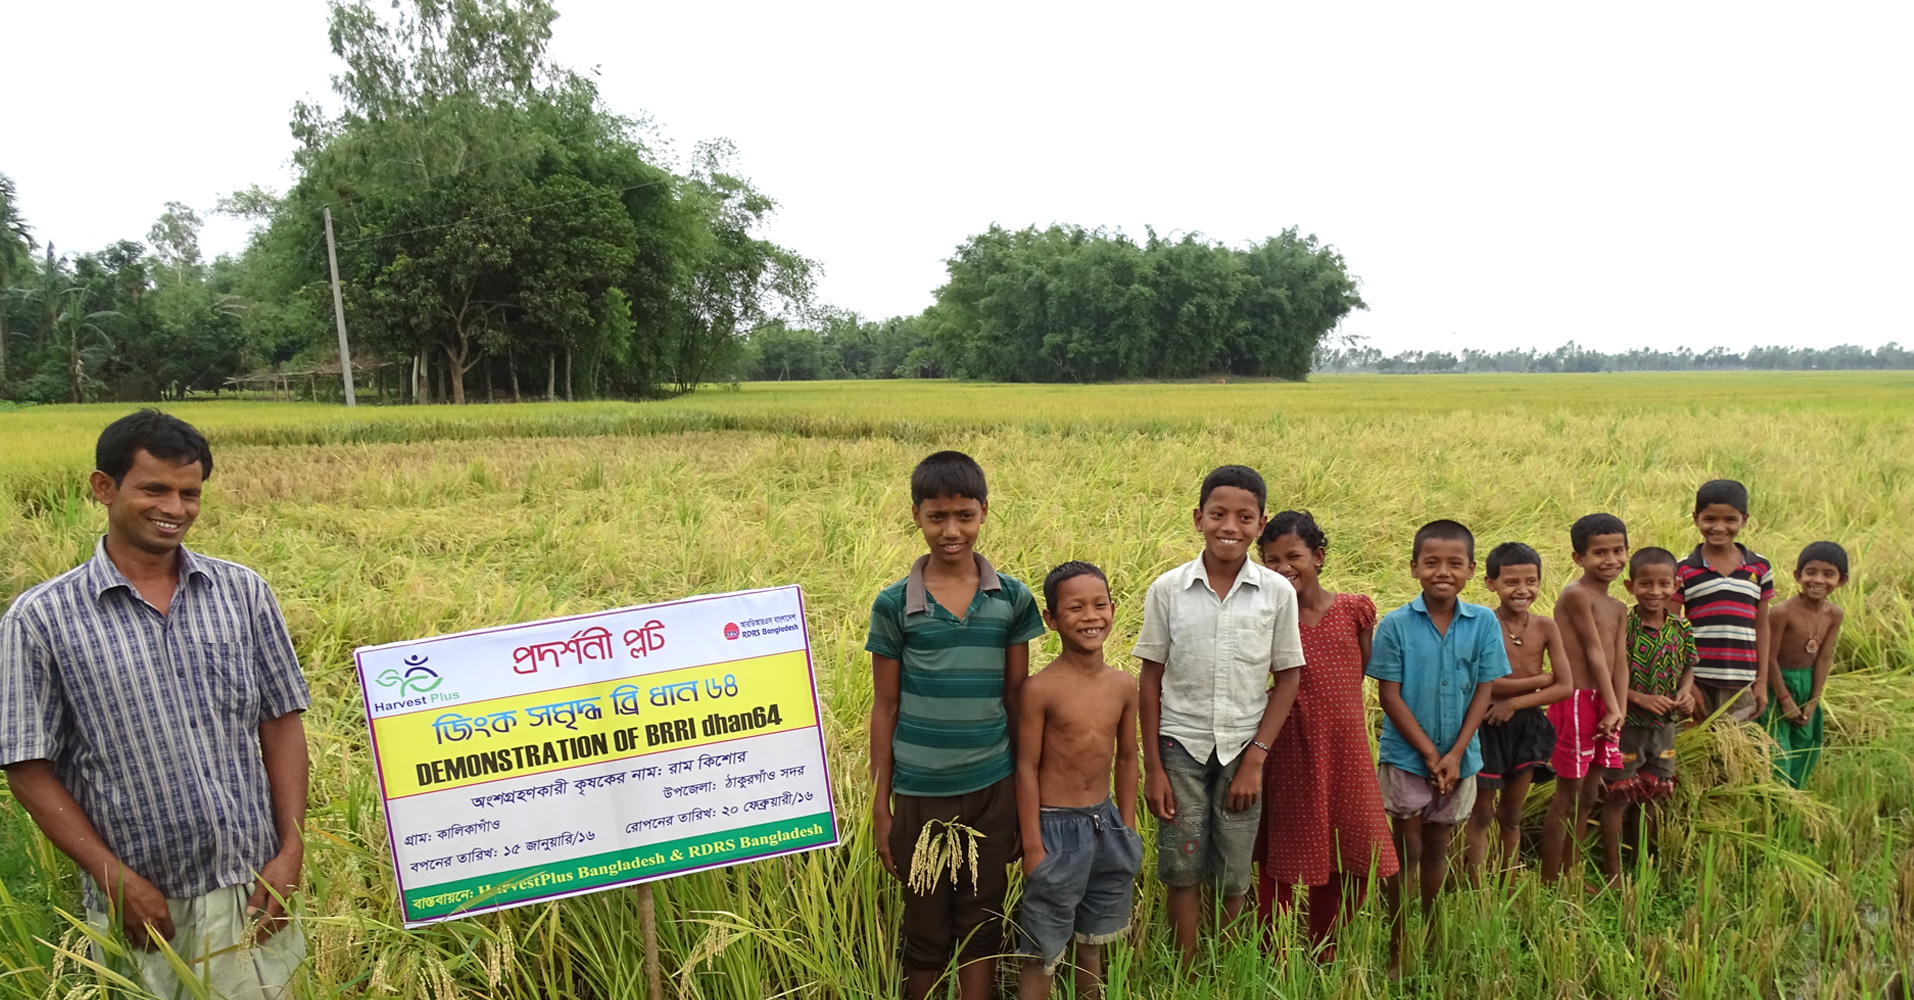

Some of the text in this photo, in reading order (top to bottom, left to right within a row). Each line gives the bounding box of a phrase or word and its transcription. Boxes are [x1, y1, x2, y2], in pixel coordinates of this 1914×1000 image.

[742, 629, 760, 639] RDRS
[762, 624, 799, 636] Bangladesh
[512, 619, 665, 675] প্রদর্শনী প্লট
[375, 691, 460, 713] Harvest Plus
[431, 673, 738, 745] জিংক সমৃদ্ধ ব্রি ধান ৬৪
[416, 704, 783, 786] DEMONSTRATION OF BRRI dhan64
[471, 778, 569, 809] অংশগ্রহণকারী
[573, 771, 628, 797] কৃষকের
[668, 758, 693, 775] রাম
[698, 750, 748, 770] কিশোর
[725, 768, 776, 790] ঠাকুরগাঁও
[780, 765, 806, 779] সদর
[436, 819, 500, 840] কালিকাগাঁও
[625, 815, 674, 835] রোপনের
[721, 806, 739, 817] ২০
[410, 856, 452, 873] বপনের
[503, 843, 521, 857] ১৫
[577, 853, 665, 879] Bangladesh
[669, 849, 684, 862] &
[688, 838, 736, 859] RDRS
[739, 823, 823, 850] Bangladesh
